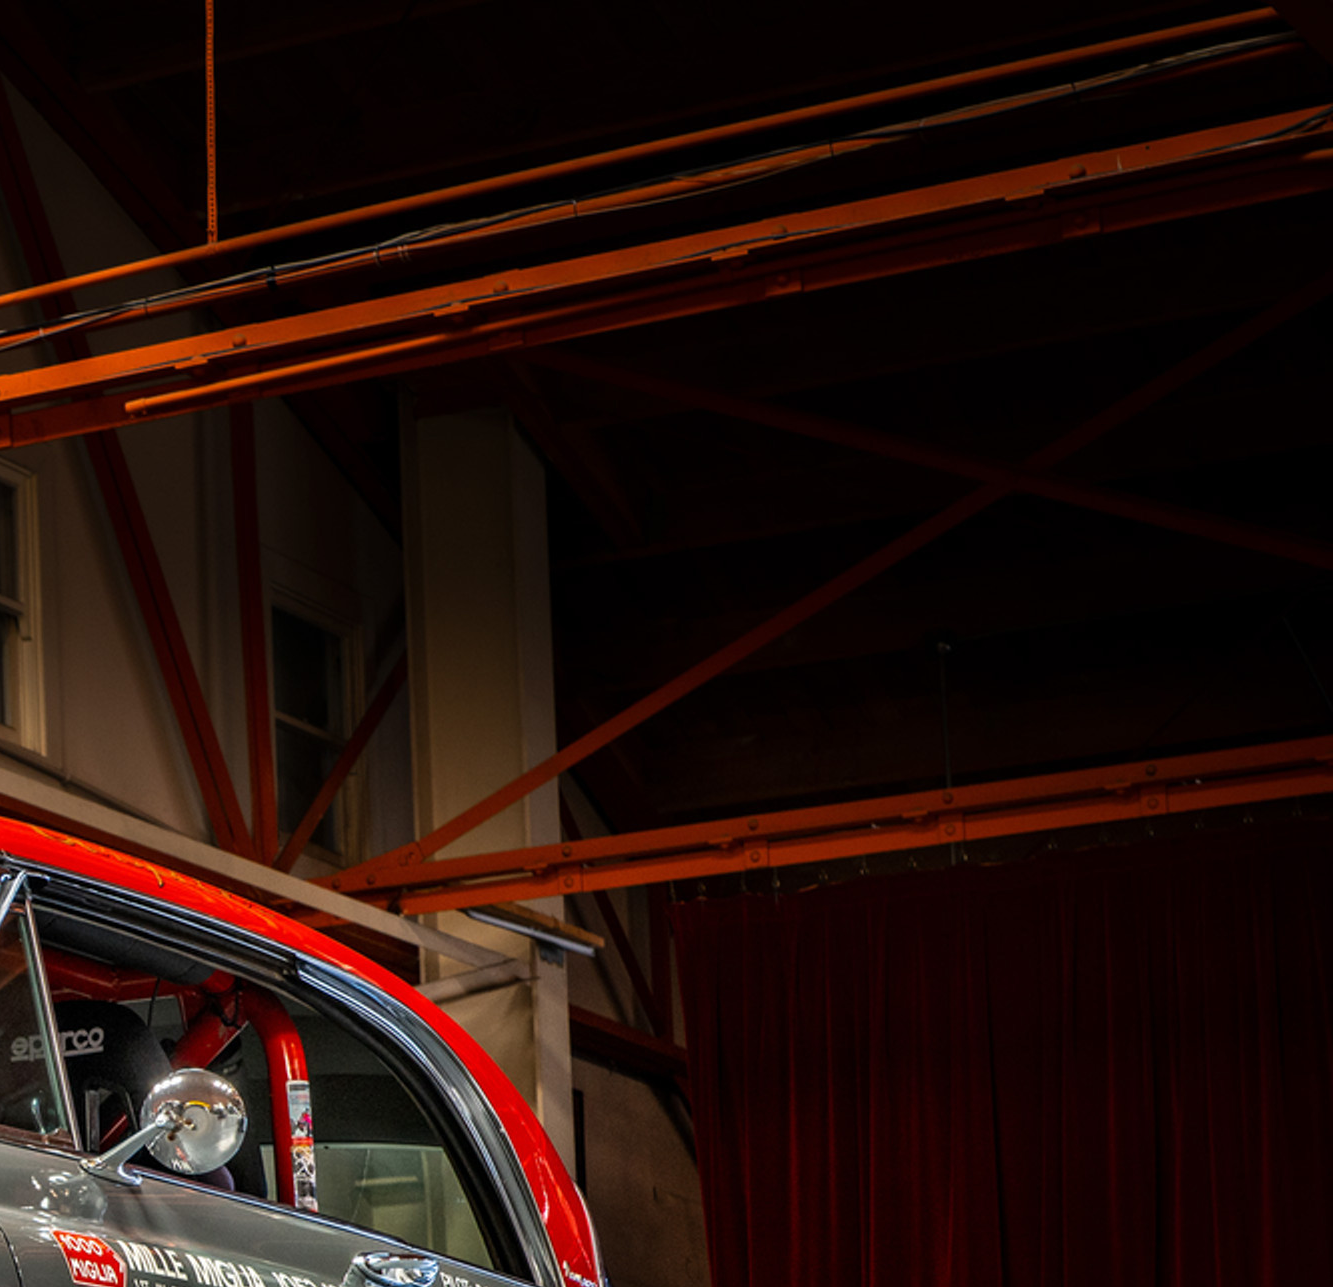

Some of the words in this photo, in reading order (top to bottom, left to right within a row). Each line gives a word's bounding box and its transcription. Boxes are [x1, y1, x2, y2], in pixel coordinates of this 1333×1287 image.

[11, 1026, 105, 1061] sprco
[59, 1234, 103, 1256] 1000
[117, 1239, 188, 1281] MILLE
[70, 1258, 119, 1285] MIGLIA
